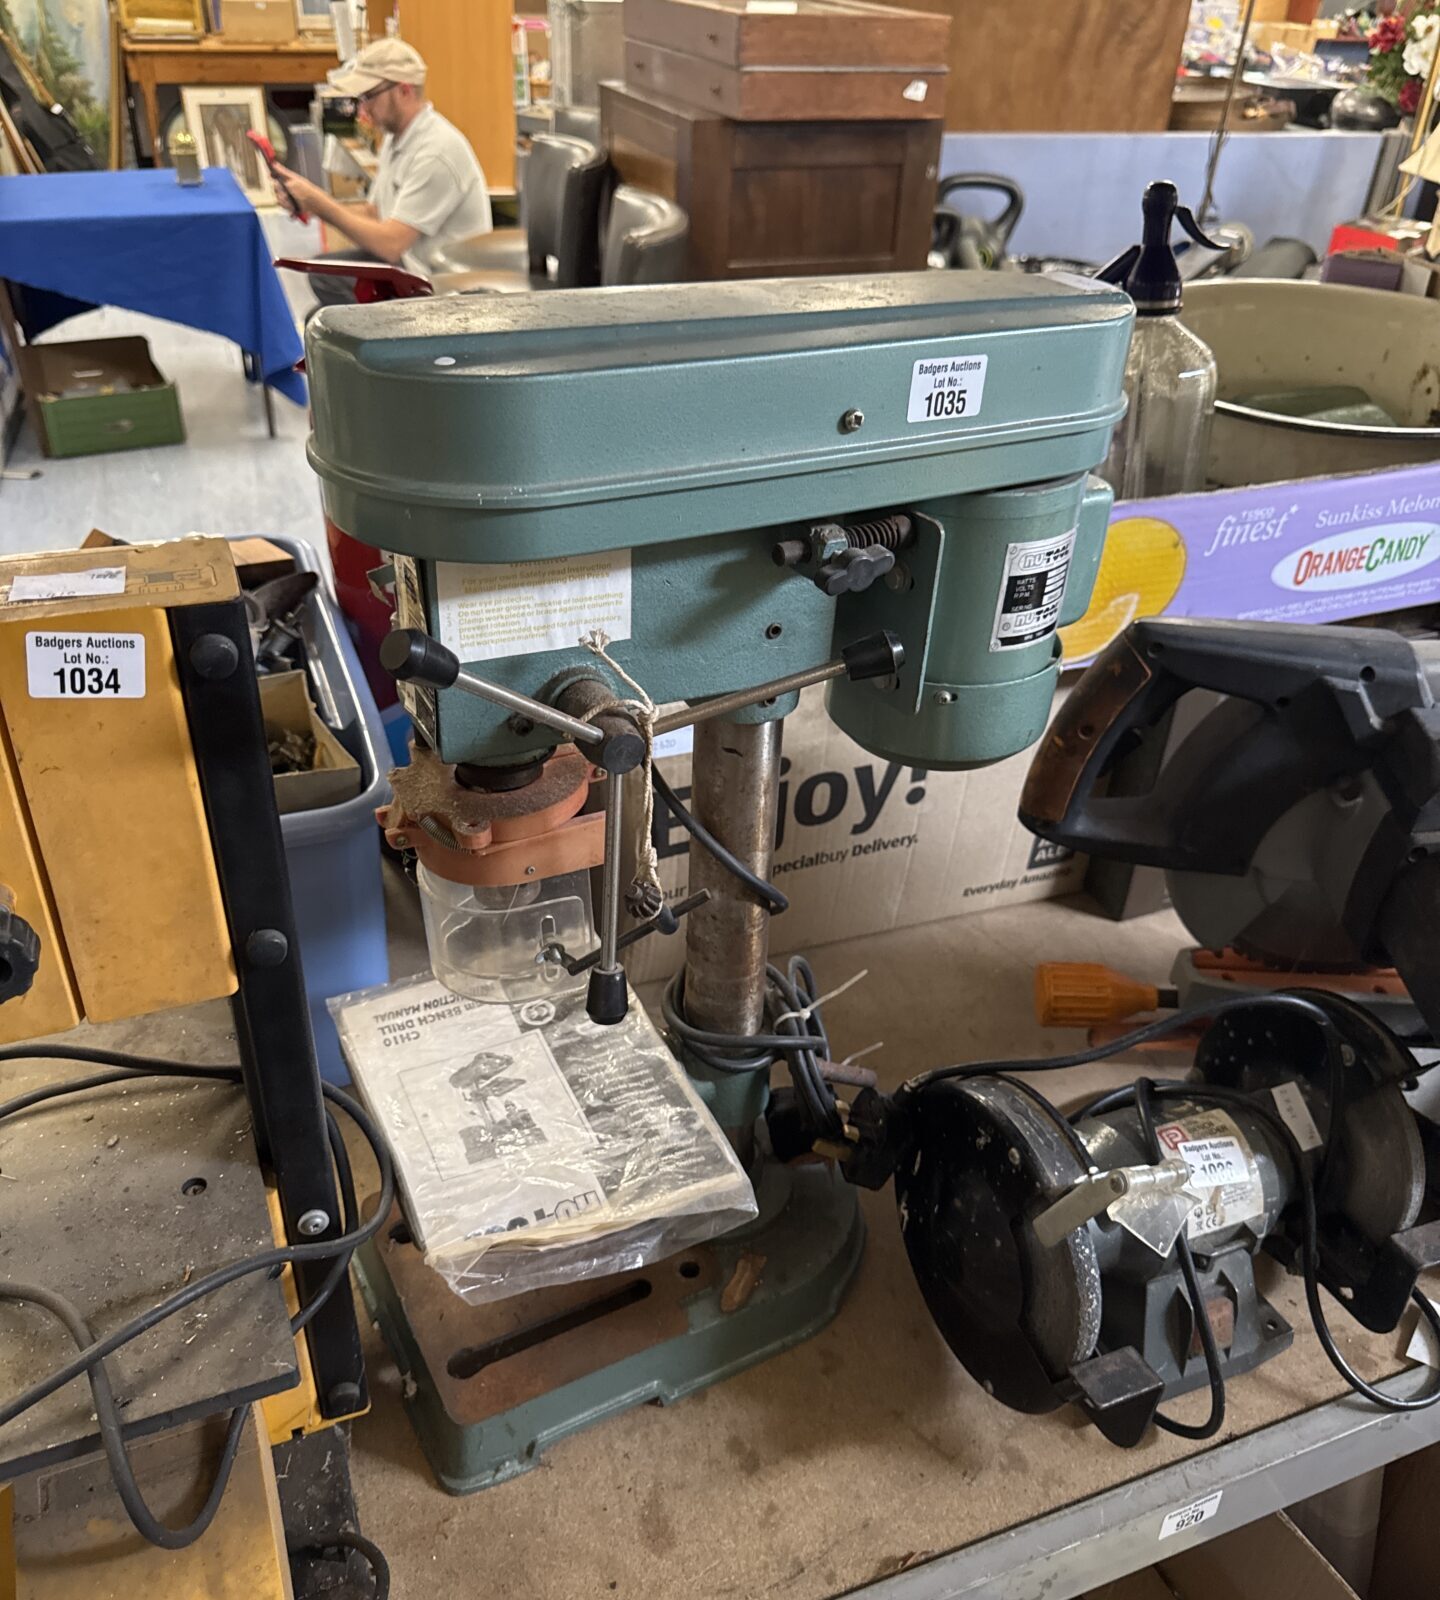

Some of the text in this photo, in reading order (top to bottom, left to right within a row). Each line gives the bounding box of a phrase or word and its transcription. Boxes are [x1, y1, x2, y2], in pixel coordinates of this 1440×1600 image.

[918, 361, 982, 376] Badgers Auctions
[934, 377, 963, 388] Lot No.:
[924, 390, 967, 418] 1035
[1315, 504, 1383, 528] Sunkiss
[479, 576, 497, 584] your
[458, 600, 477, 608] Wear
[479, 600, 490, 608] eye
[459, 617, 484, 626] Clamp
[35, 636, 135, 650] Badgers Auctions
[64, 652, 109, 664] Lot No.:
[54, 667, 121, 694] 1034
[772, 847, 848, 877] pecialbuy
[661, 885, 687, 902] our
[962, 877, 1018, 897] Everyday
[373, 1003, 421, 1024] MANUAL
[418, 1006, 462, 1025] BENCH
[378, 1019, 414, 1036] DRILL
[1175, 1510, 1204, 1532] 920
